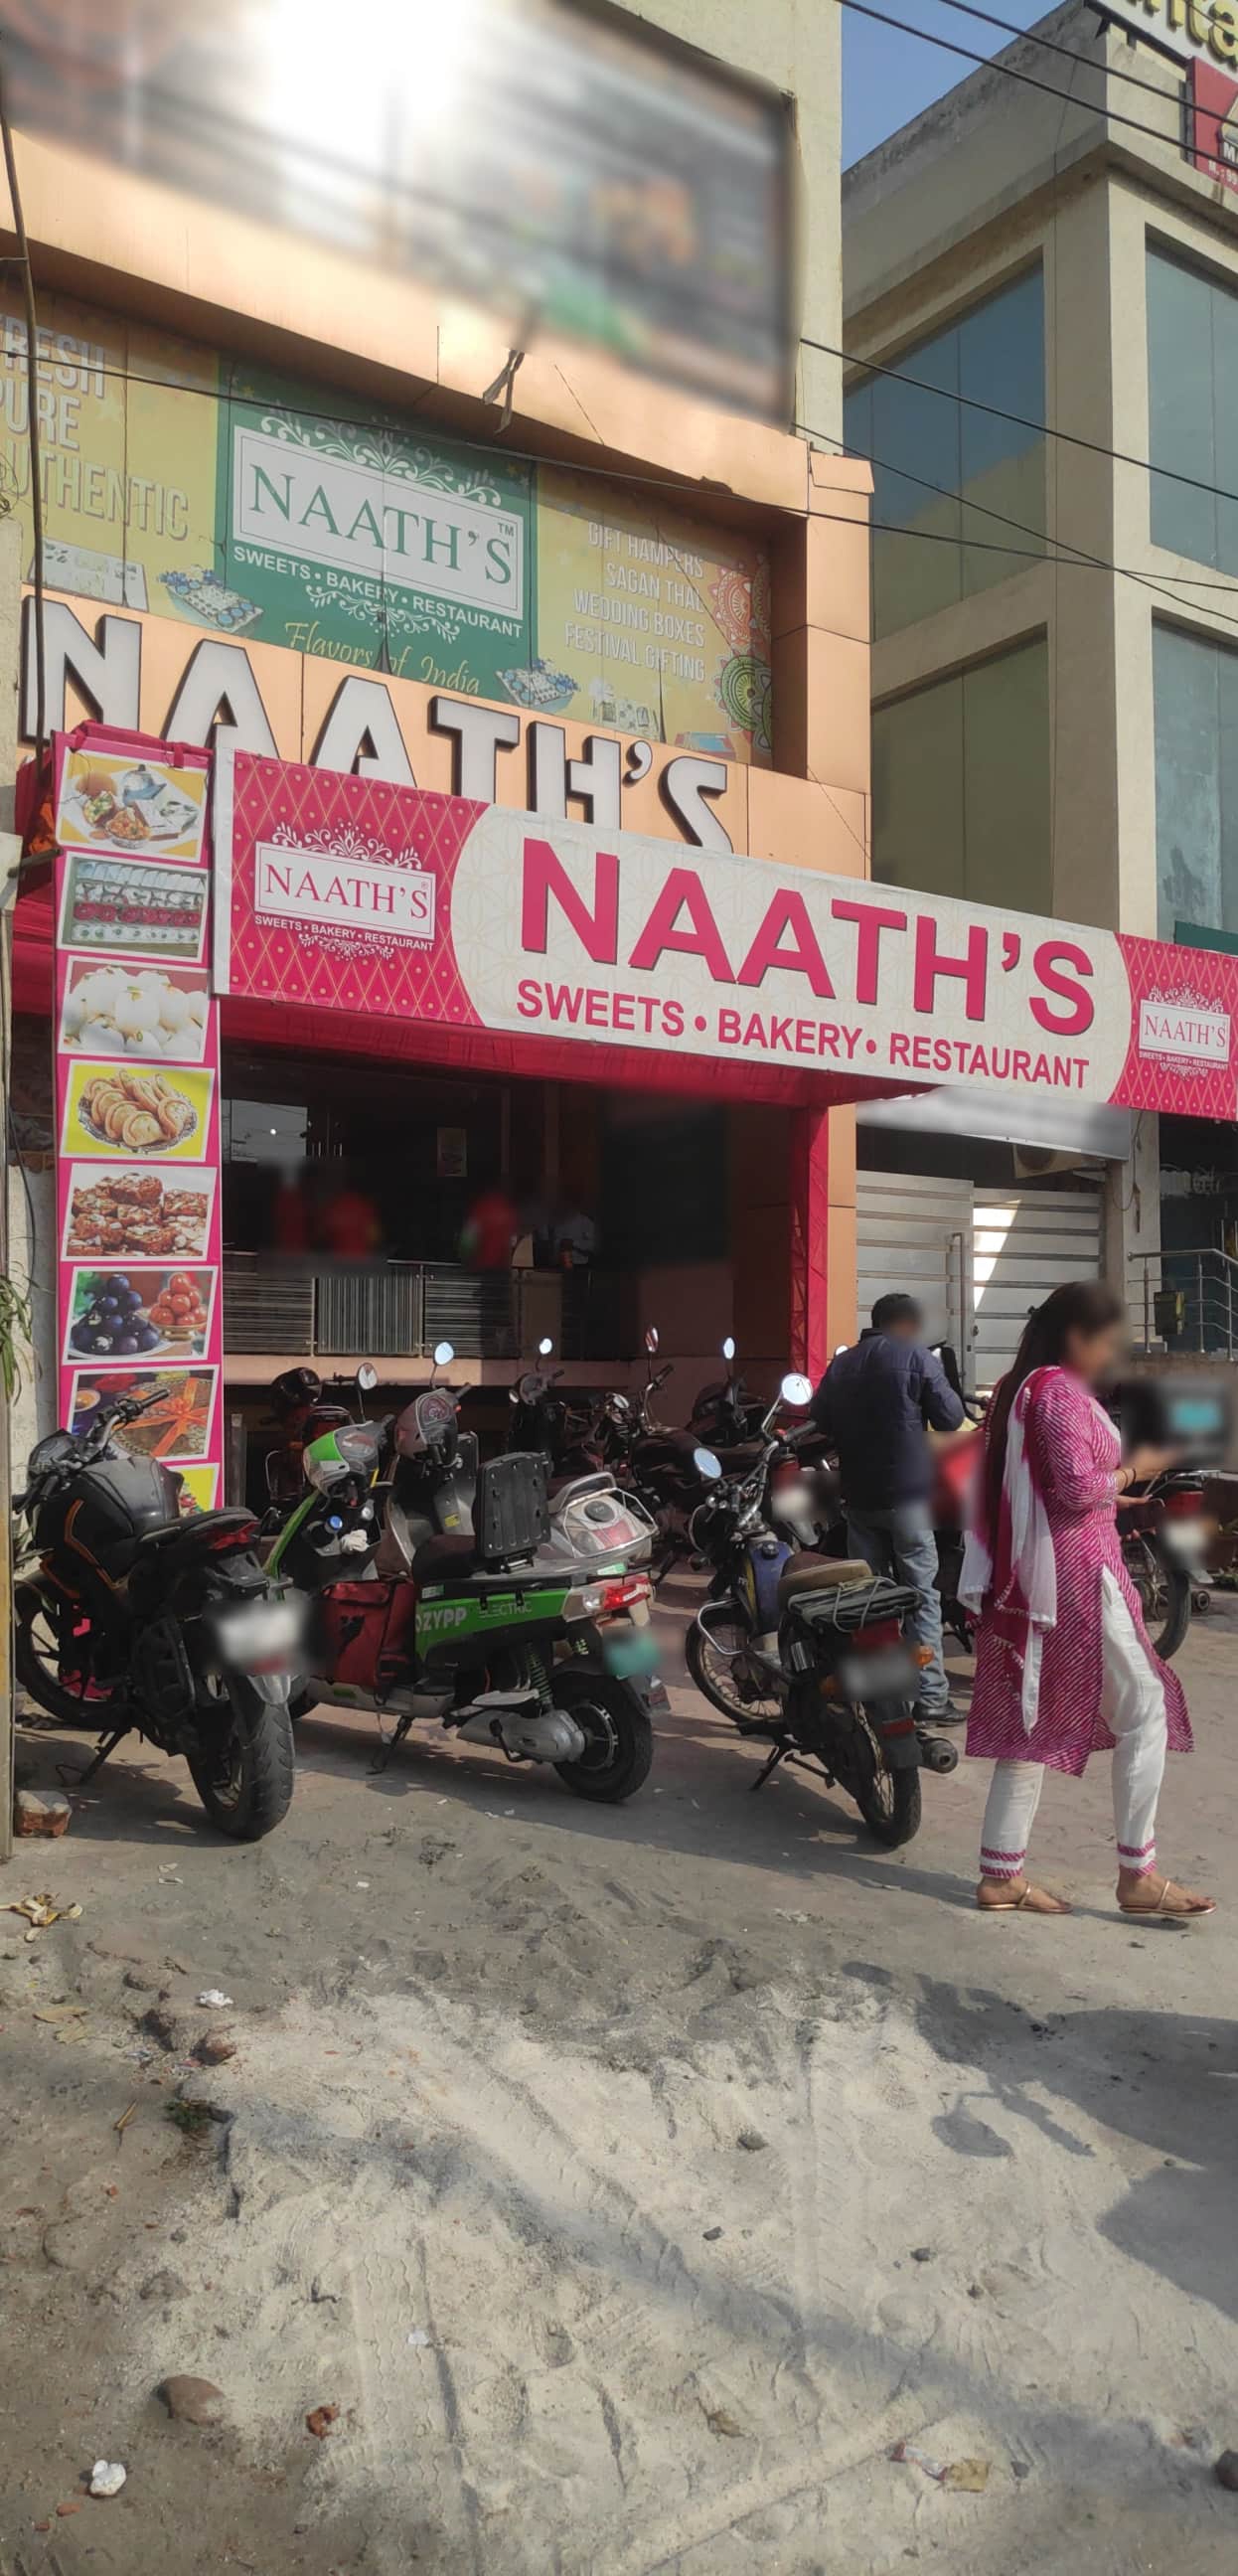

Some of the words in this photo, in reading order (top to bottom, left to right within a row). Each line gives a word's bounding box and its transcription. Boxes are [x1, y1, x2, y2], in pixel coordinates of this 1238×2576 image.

[0, 315, 104, 399] RESH
[0, 378, 80, 450] URE
[3, 439, 189, 541] UTHENTIC
[248, 463, 513, 586] NAATH'S
[588, 522, 622, 553] GIFT
[628, 534, 703, 578] HAMPERS
[233, 546, 311, 580] SWEETS
[327, 571, 398, 604] BAKERY
[412, 595, 524, 639] RESTAURANT
[573, 588, 649, 633] WEDDING
[654, 611, 704, 648] BOXES
[606, 563, 661, 601] SAGAN
[666, 579, 703, 614] THAL
[285, 620, 374, 667] Flavors
[388, 645, 413, 677] of
[421, 655, 480, 695] India
[564, 621, 641, 667] FESTIVAL
[646, 644, 704, 683] GIFTING
[20, 593, 733, 854] NAATH'S
[264, 864, 428, 920] NAATH'S
[254, 914, 302, 931] SWEETS
[311, 924, 356, 939] BAKERY
[365, 932, 434, 952] RESTAURANT
[522, 837, 1095, 1036] NAATH'S
[516, 979, 686, 1037] SWEETS
[717, 1008, 862, 1060] BAKERY
[889, 1032, 1090, 1088] RESTAURANT
[1145, 1015, 1226, 1048] NAATH'S
